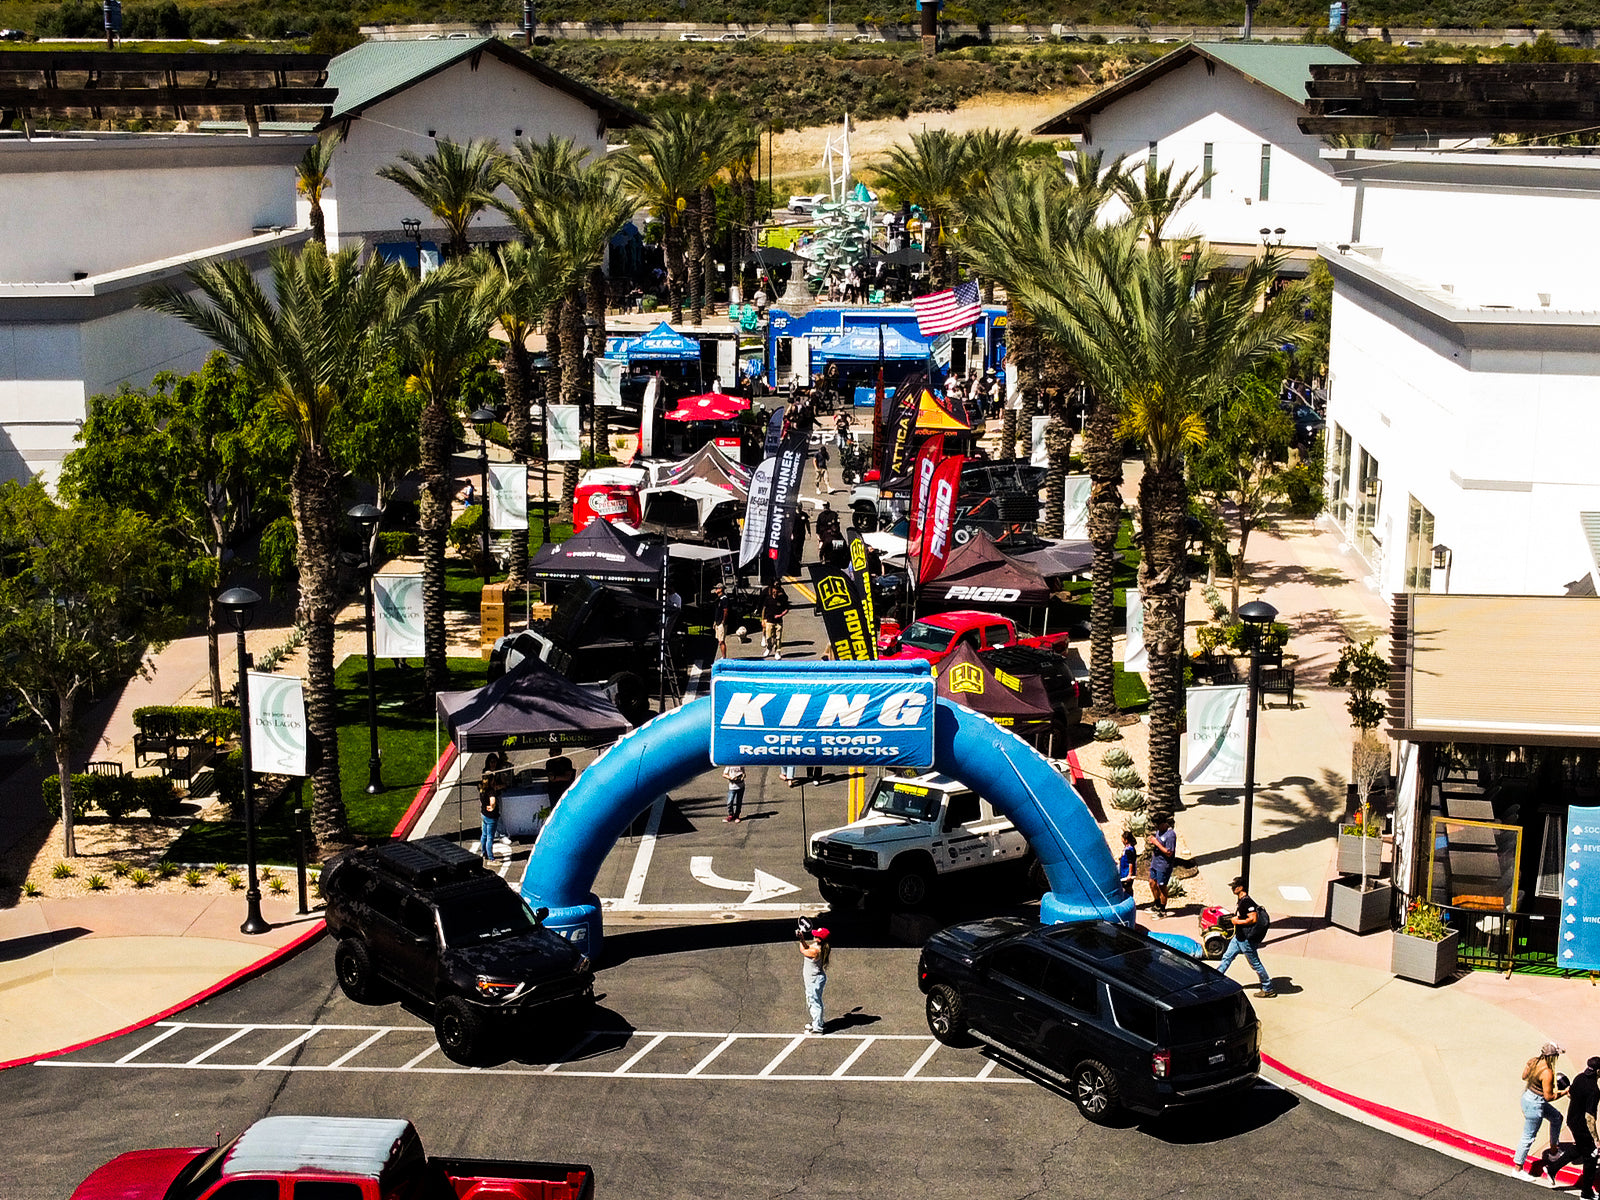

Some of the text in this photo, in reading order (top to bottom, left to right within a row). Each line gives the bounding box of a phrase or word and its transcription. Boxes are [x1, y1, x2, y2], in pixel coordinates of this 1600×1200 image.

[891, 418, 911, 474] ATTICA
[769, 450, 793, 549] FRONT RUNNER
[930, 478, 953, 560] RIGID
[944, 585, 1021, 603] RIGID
[720, 692, 928, 727] KING
[549, 732, 558, 743] &
[739, 744, 900, 757] RACING SHOCKS
[764, 735, 804, 745] OFF
[821, 735, 882, 746] ROAD
